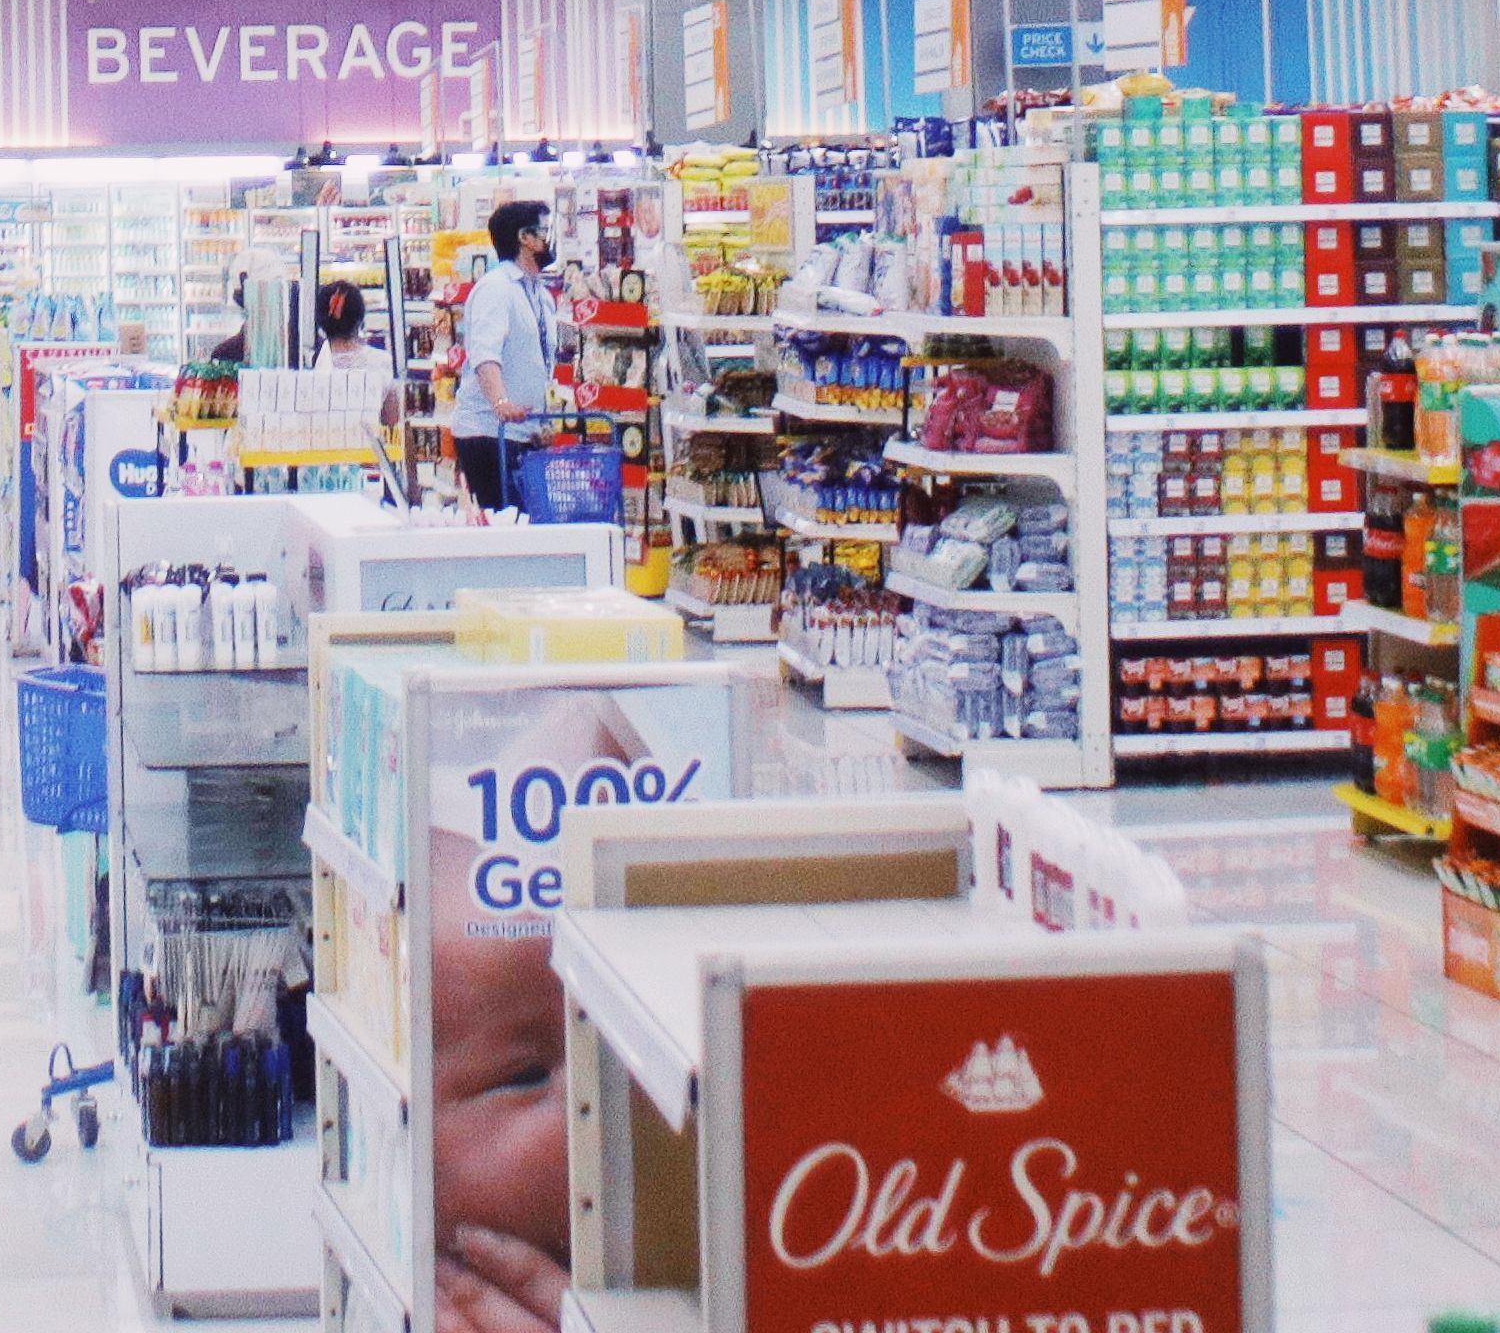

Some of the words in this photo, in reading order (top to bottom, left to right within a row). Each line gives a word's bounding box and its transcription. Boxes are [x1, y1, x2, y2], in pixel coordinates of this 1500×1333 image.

[1022, 32, 1064, 46] PRICE
[86, 20, 482, 85] BEVERAGE
[1019, 46, 1066, 60] CHECK
[118, 462, 159, 487] Hug
[769, 1141, 958, 1271] Old
[967, 1137, 1216, 1277] Spice
